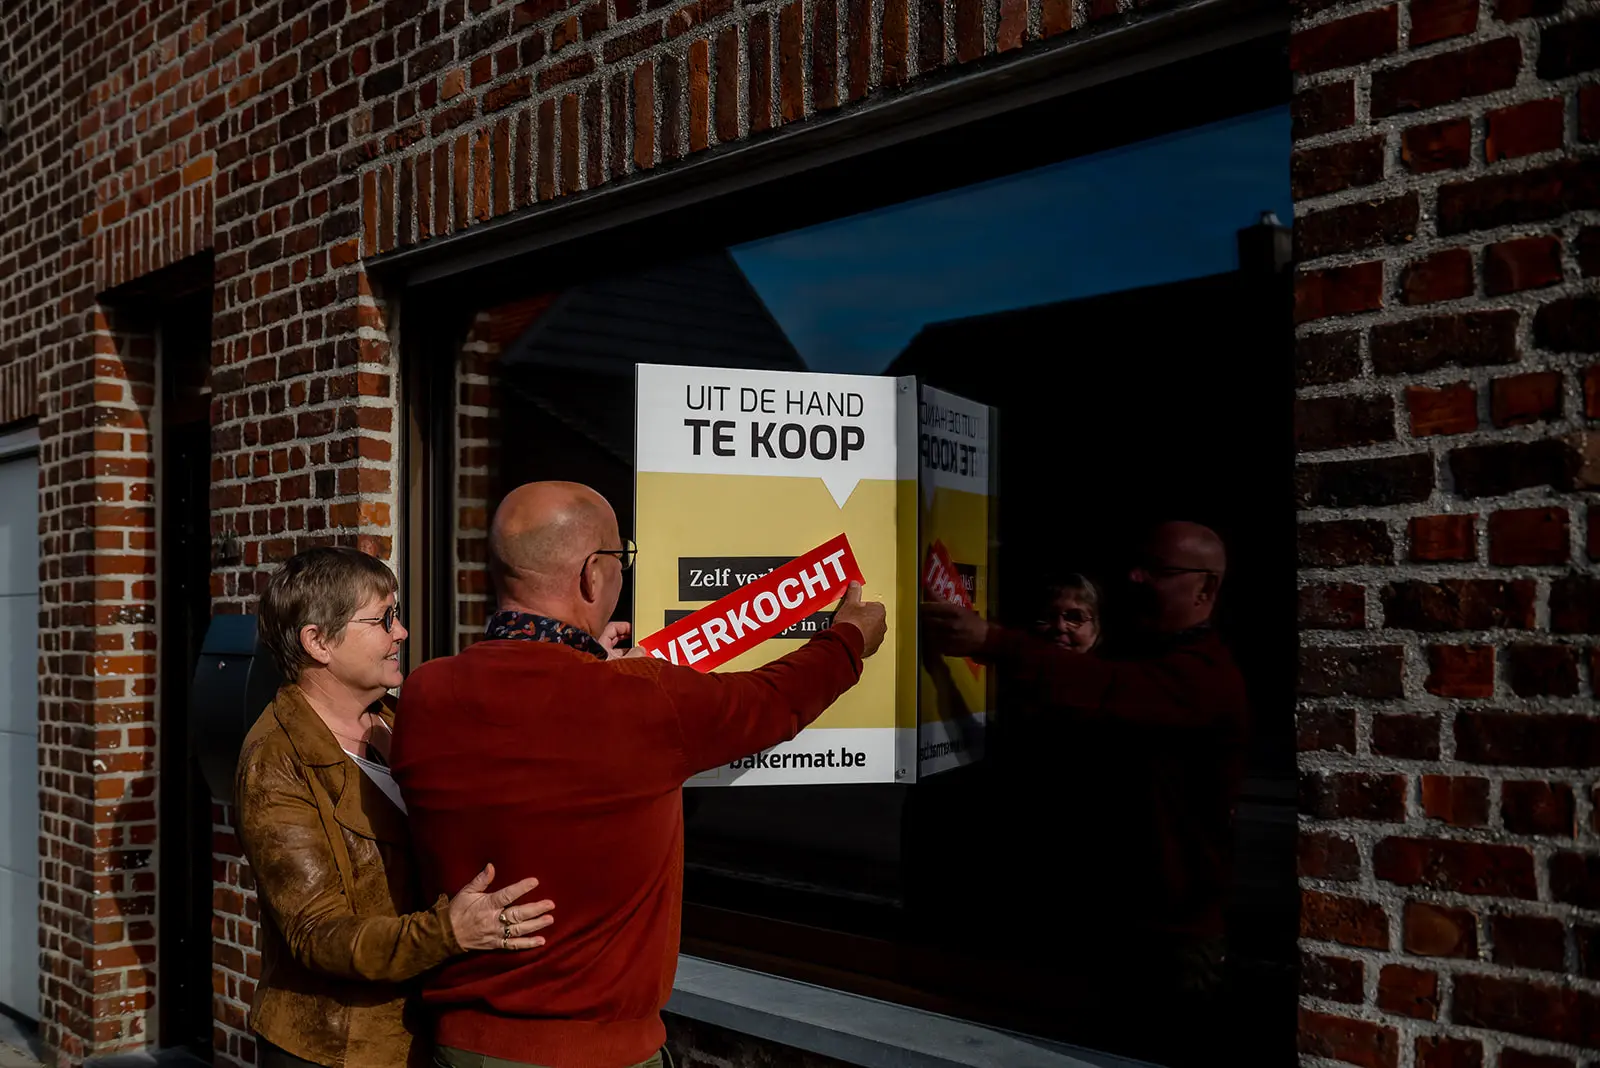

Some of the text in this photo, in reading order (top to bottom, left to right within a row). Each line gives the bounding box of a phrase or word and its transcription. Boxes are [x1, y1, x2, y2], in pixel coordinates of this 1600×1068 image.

[686, 385, 864, 418] UIT DE HAND
[683, 419, 866, 462] TE KOOP
[689, 568, 731, 587] Zelf
[650, 548, 846, 666] VERKOCHT
[801, 619, 817, 632] in
